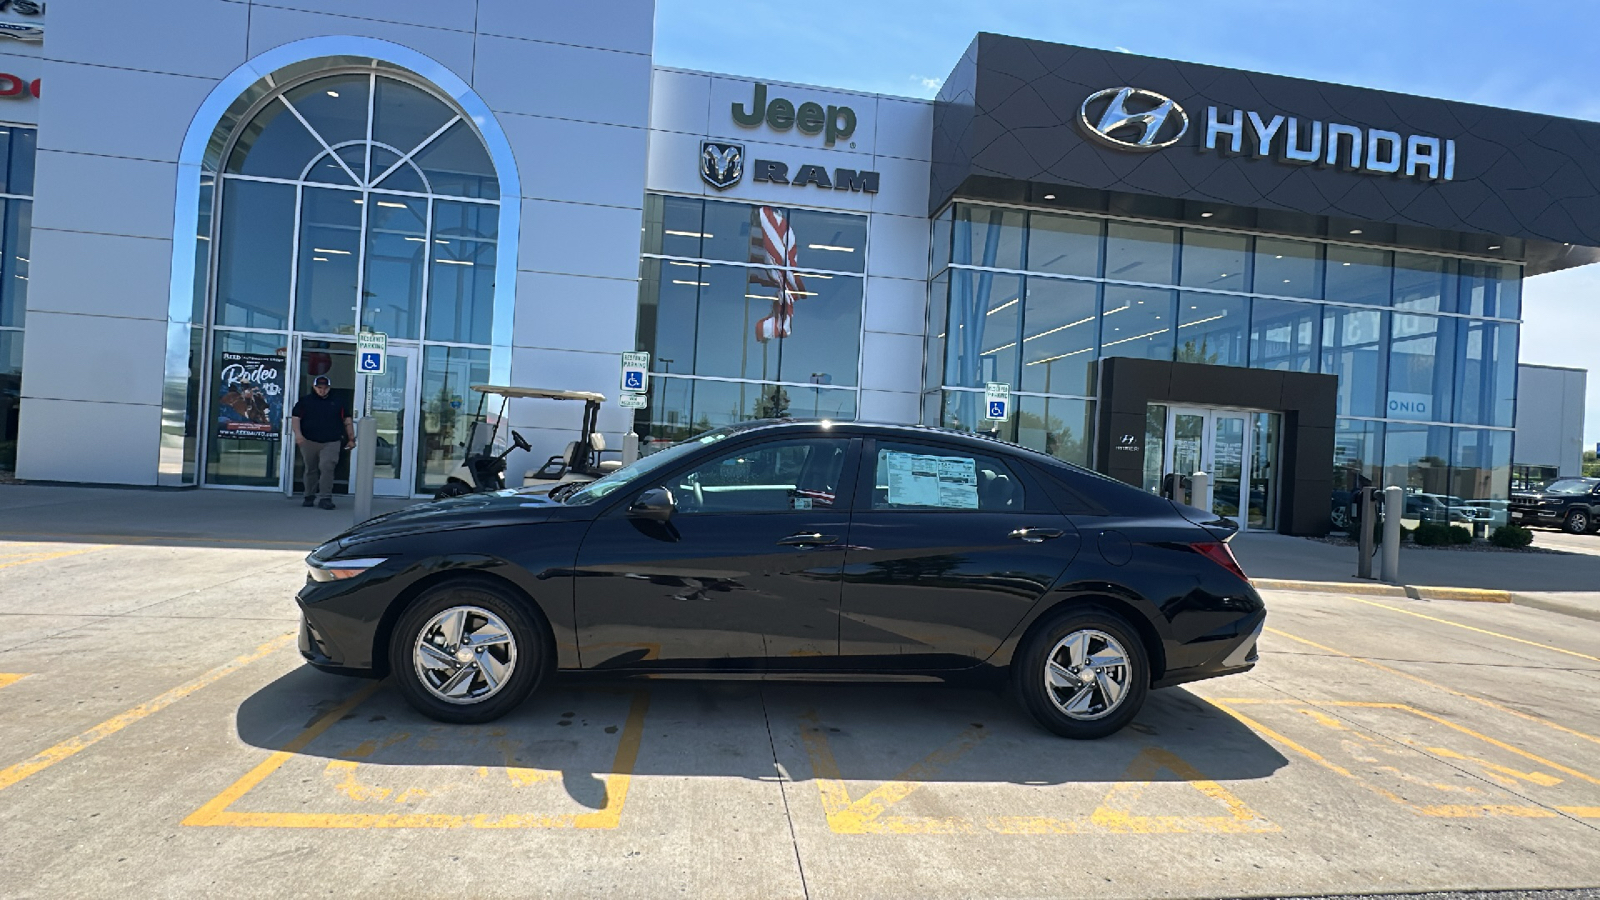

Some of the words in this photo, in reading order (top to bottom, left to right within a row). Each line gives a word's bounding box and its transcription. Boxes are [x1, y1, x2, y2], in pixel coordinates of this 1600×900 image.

[731, 83, 857, 147] Jeep
[1204, 106, 1456, 181] HYUNDAI
[753, 158, 880, 194] RAM
[221, 363, 278, 388] Rodeo
[1389, 400, 1426, 413] ONIQ
